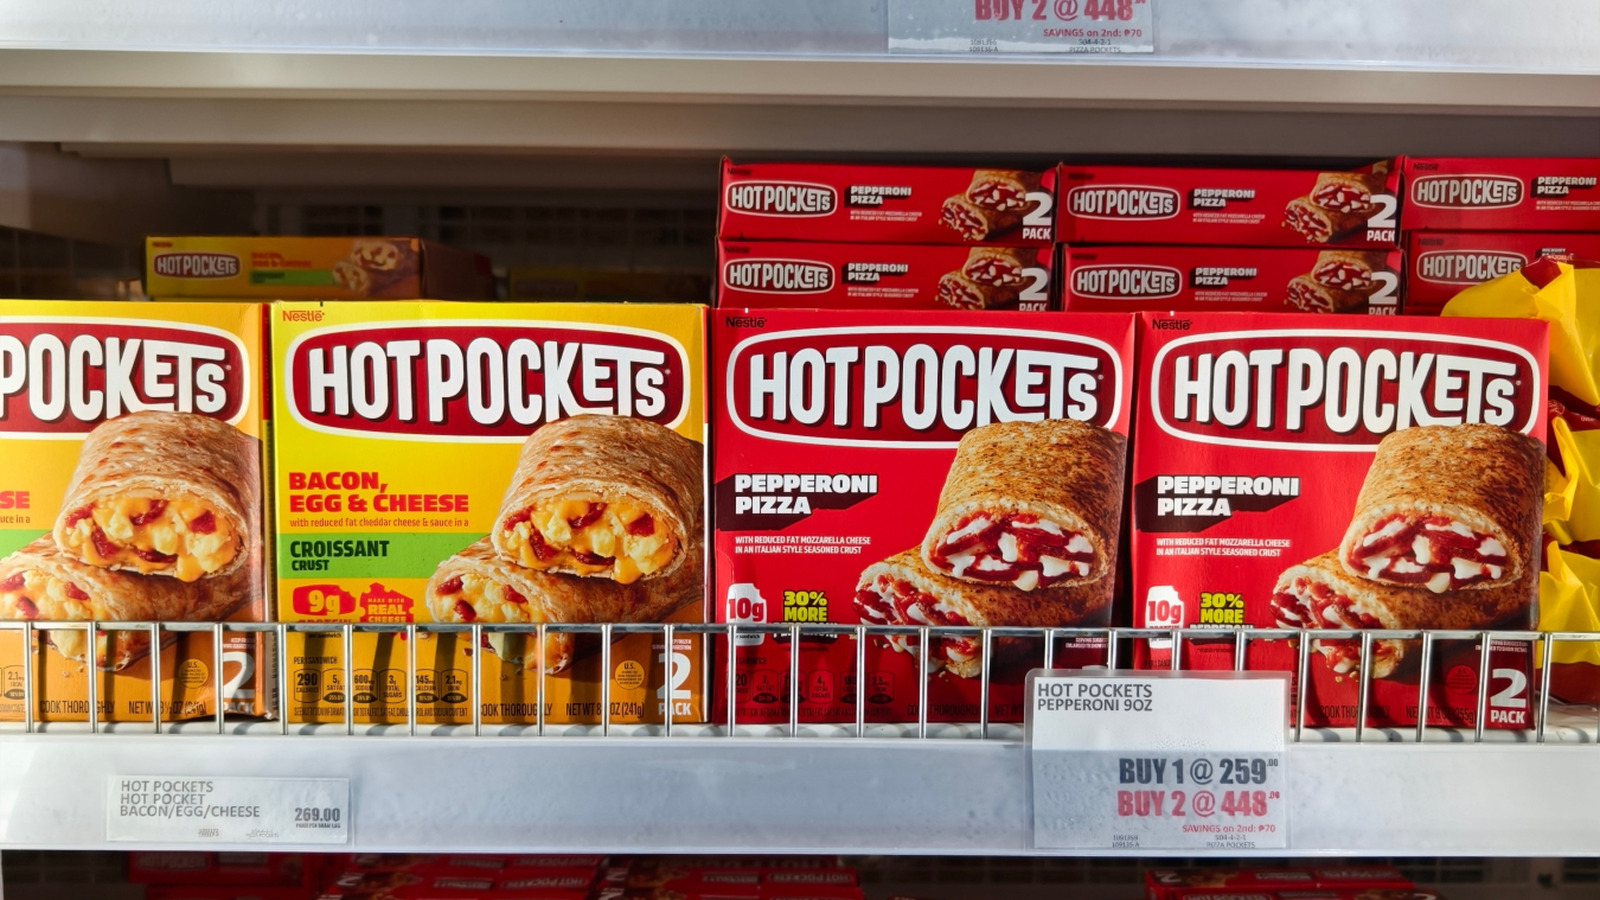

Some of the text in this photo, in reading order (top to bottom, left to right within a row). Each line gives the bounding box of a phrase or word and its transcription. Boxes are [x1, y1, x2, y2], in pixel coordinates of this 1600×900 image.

[974, 0, 1024, 21] BUY
[1031, 0, 1047, 20] 2
[1043, 28, 1084, 37] SAVINGS
[1100, 29, 1122, 37] 2nd:
[1537, 176, 1597, 186] PEPPERONI
[850, 186, 912, 196] PEPPERONI
[1193, 188, 1256, 198] PEPPERONI
[1417, 179, 1518, 204] HOT POCKETS
[1536, 186, 1570, 194] PIZZA
[731, 186, 831, 211] HOT POCKETS
[850, 195, 883, 205] PIZZA
[1073, 190, 1174, 214] HOT POCKETS
[1193, 198, 1226, 207] PIZZA
[1022, 191, 1053, 226] 2
[1367, 194, 1398, 228] 2
[1022, 228, 1051, 240] PACK
[1366, 230, 1395, 241] PACK
[156, 254, 238, 276] HOT POCKETS
[847, 263, 909, 272] PEPPERONI
[1195, 267, 1257, 277] PEPPERONI
[1423, 255, 1521, 280] HOT POCKETS
[729, 263, 828, 289] HOT POCKETS
[847, 272, 880, 281] PIZZA
[1077, 269, 1175, 294] HOT POCKETS
[1195, 277, 1228, 285] PIZZA
[1018, 267, 1049, 301] 2
[1368, 271, 1398, 304] 2
[1018, 303, 1047, 312] PACK
[1368, 307, 1396, 315] PACK
[0, 333, 229, 422] POCKETS
[307, 336, 667, 426] HOT POCKETS
[748, 343, 1100, 431] HOT POCKETS
[1172, 346, 1519, 434] HOT POCKETS
[288, 471, 389, 494] BACON,
[734, 474, 878, 494] PEPPERONI
[1156, 476, 1300, 496] PEPPERONI
[289, 494, 470, 513] EGG & CHEESE
[734, 496, 812, 515] PIZZA
[1156, 497, 1232, 516] PIZZA
[16, 514, 24, 523] in
[289, 517, 469, 528] with reduced fat cheddar cheese & sauce in a
[734, 536, 871, 545] WITH REDUCED FAT MOZZARELLA CHEESE
[1156, 538, 1291, 548] WITH REDUCED FAT MOZZARELLA CHEESE
[289, 540, 390, 558] CROISSANT
[734, 545, 862, 554] IN AN ITALIAN STYLE SEASONED CRUST
[1156, 547, 1281, 557] IN AN ITALIAN STYLE SEASONED CRUST
[291, 559, 330, 571] CRUST
[307, 589, 341, 617] 9g
[783, 591, 828, 607] 30%
[1200, 592, 1244, 608] 30%
[367, 604, 406, 615] REAL
[727, 597, 765, 622] 10g
[783, 607, 828, 621] MORE
[1148, 600, 1182, 622] 10g
[1200, 608, 1244, 623] MORE
[222, 651, 255, 699] 2
[297, 673, 318, 686] 290
[656, 652, 692, 700] 2
[1037, 683, 1153, 698] HOT POCKETS
[1489, 667, 1527, 708] 2
[40, 700, 61, 714] COOK
[62, 700, 116, 714] THOROGHLY
[128, 701, 144, 714] NET
[500, 702, 553, 716] THOROUGLY
[566, 701, 645, 719] NET WT OZ (241g)
[1037, 699, 1153, 711] PEPPERONI 9OZ
[1489, 709, 1526, 724] PACK
[1119, 758, 1167, 784] BUY
[1171, 758, 1184, 784] 1
[1189, 758, 1213, 785] @
[121, 780, 214, 793] HOT POCKETS
[121, 793, 206, 805] HOT POCKET
[1116, 790, 1166, 817] BUY
[1171, 790, 1186, 816] 2
[1191, 790, 1216, 818] @
[120, 805, 261, 819] BACON/EGG/CHEESE
[294, 807, 341, 822] 269.00
[1182, 824, 1221, 833] SAVINGS
[1223, 825, 1235, 833] on
[1236, 824, 1257, 833] 2nd:
